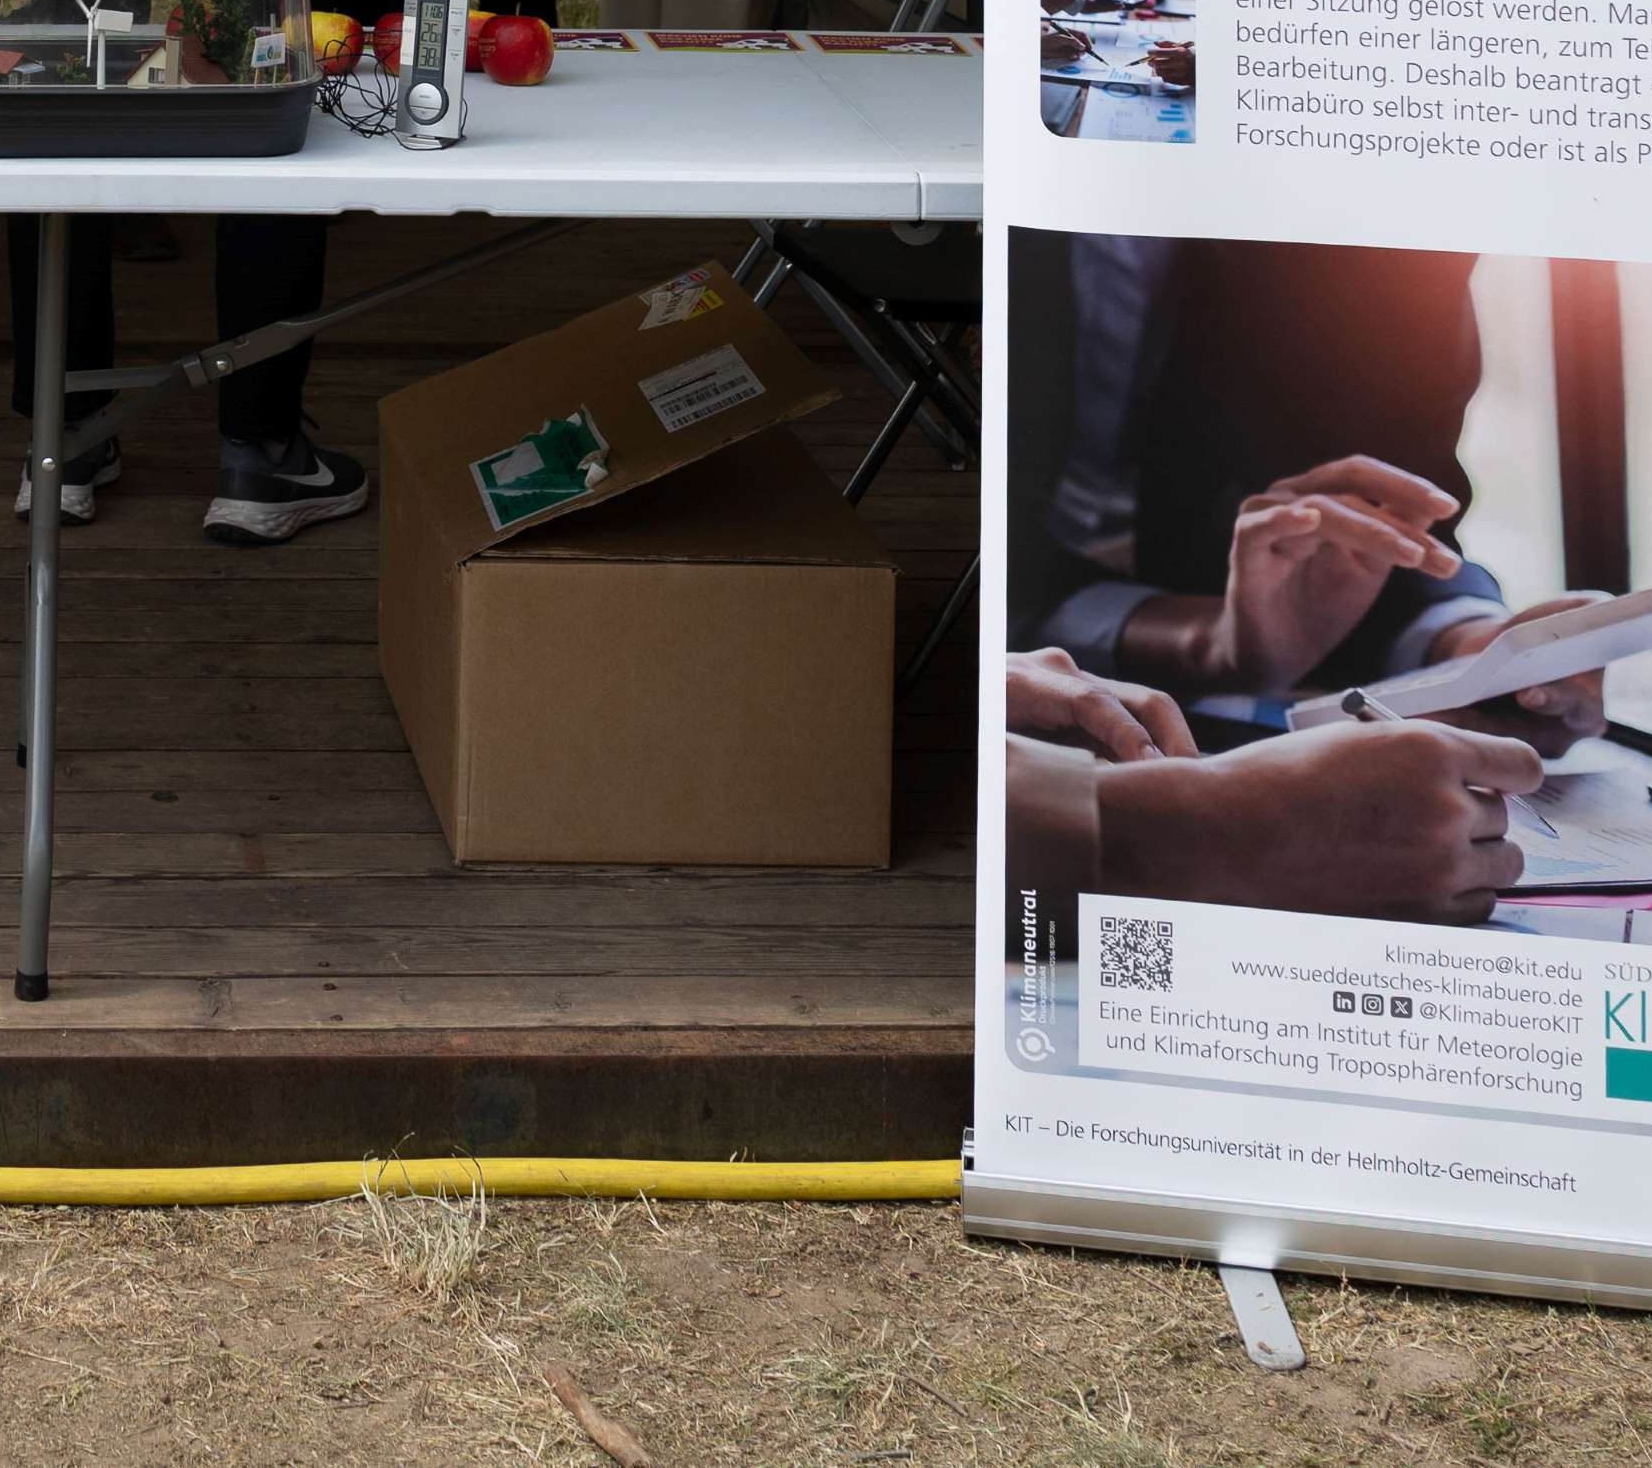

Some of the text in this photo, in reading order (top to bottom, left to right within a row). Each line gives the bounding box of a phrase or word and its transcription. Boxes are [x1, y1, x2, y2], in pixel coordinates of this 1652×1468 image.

[1020, 888, 1038, 1024] Klimaneutral
[1232, 961, 1583, 1007] www.sueddeutsches-klimabuero.de
[1386, 945, 1582, 981] klimabuero@kit.edu
[1100, 1001, 1583, 1070] Eine Einrichtung am Institut für Meteorologie
[1420, 1002, 1583, 1034] @KlimabueroKIT
[1107, 1033, 1582, 1101] und Klimaforschung Troposphärenforschung
[1006, 1114, 1033, 1134] KIT
[1057, 1120, 1084, 1139] Die
[1092, 1124, 1282, 1161] Forschungsuniversität
[1289, 1143, 1303, 1162] in
[1311, 1146, 1341, 1166] der
[1348, 1150, 1577, 1193] Helmholtz-Gemeinschaft
